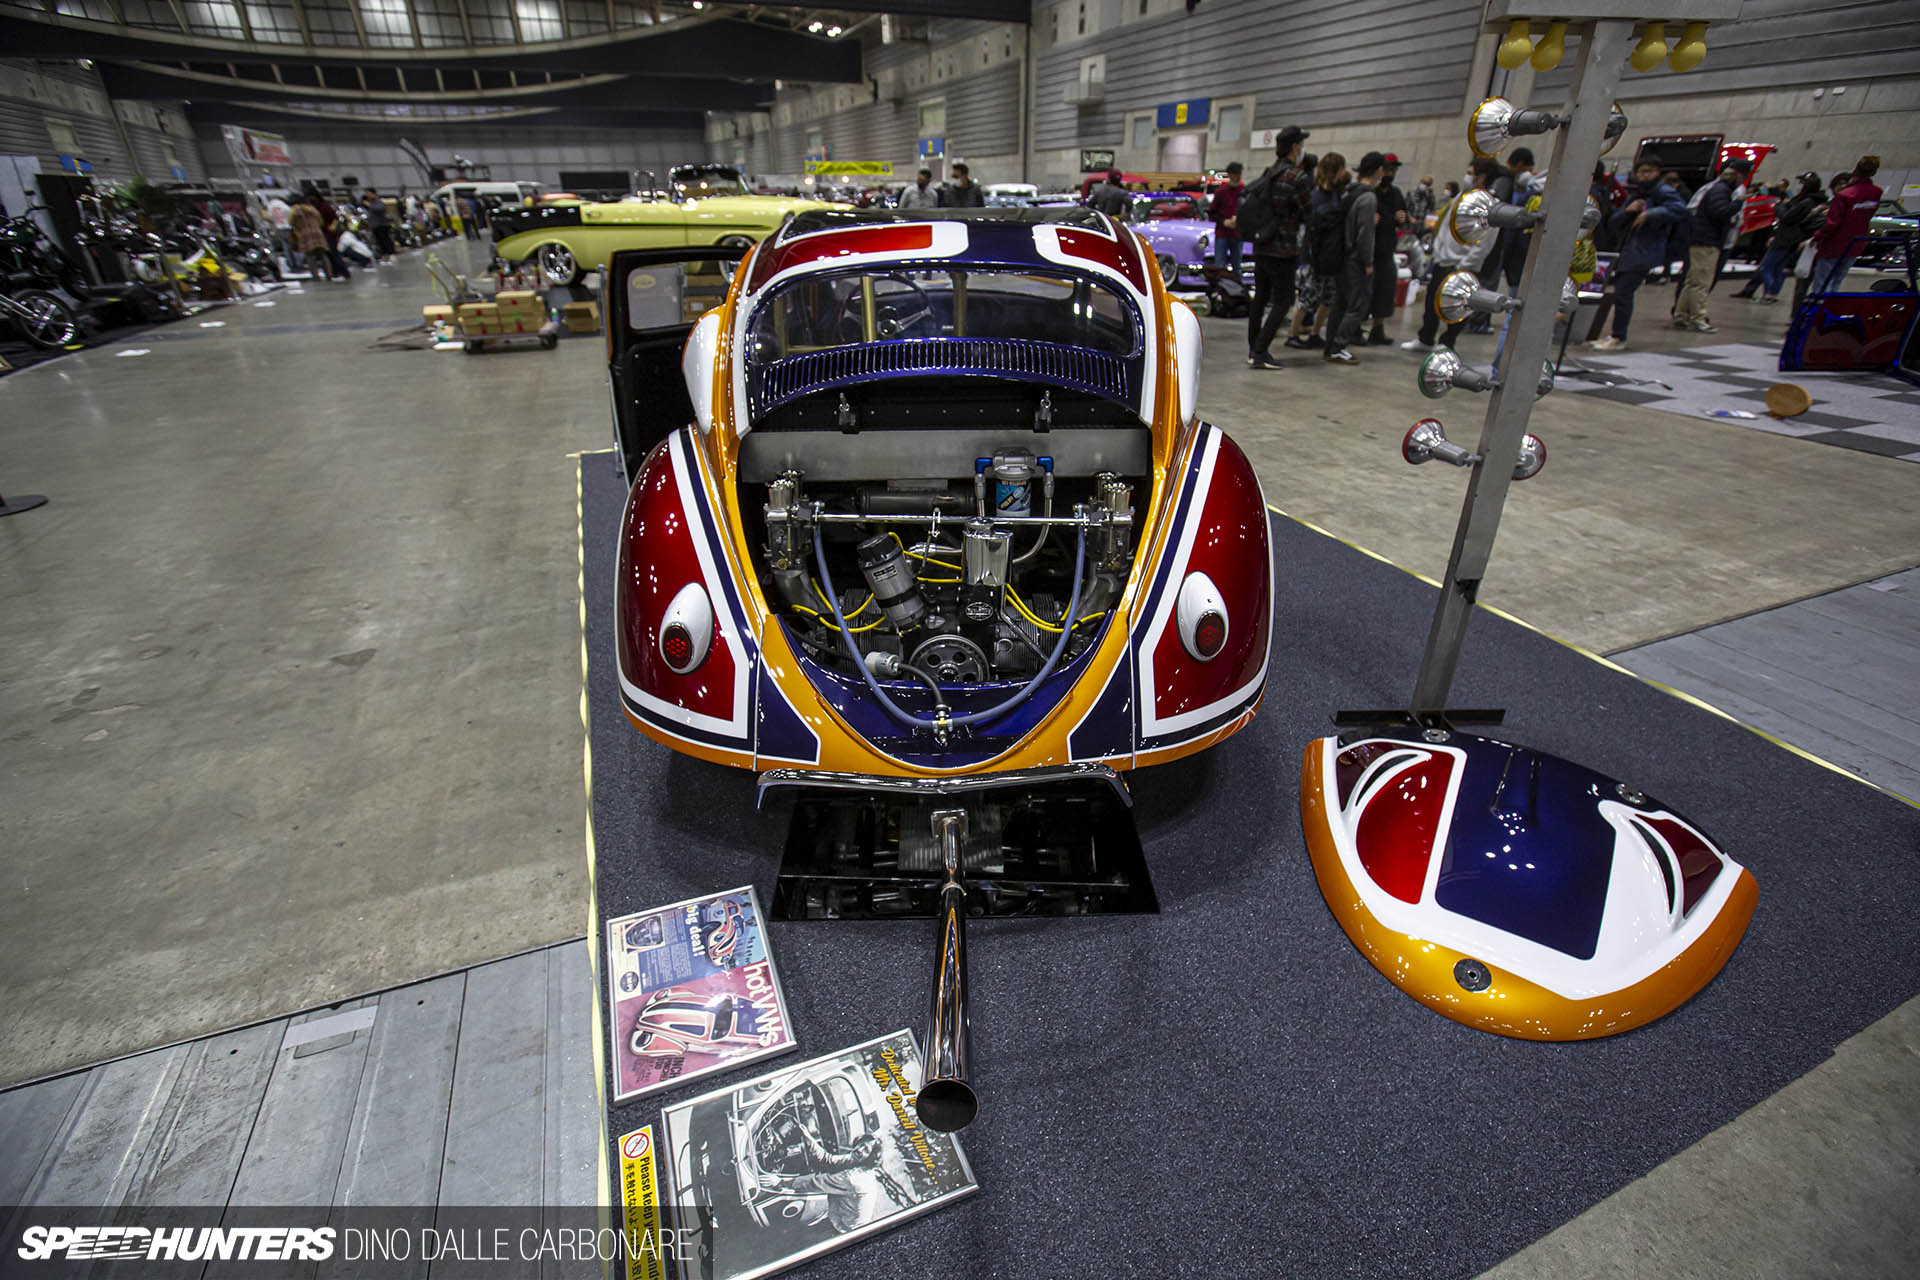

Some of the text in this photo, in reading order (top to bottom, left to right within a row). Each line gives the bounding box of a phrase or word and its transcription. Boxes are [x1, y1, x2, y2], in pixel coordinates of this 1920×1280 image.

[684, 904, 706, 957] big deal!
[880, 1047, 916, 1096] Dedicated
[872, 1067, 891, 1092] Mr.
[886, 1090, 917, 1130] Darrell
[640, 1156, 652, 1192] Please
[642, 1191, 653, 1220] keep
